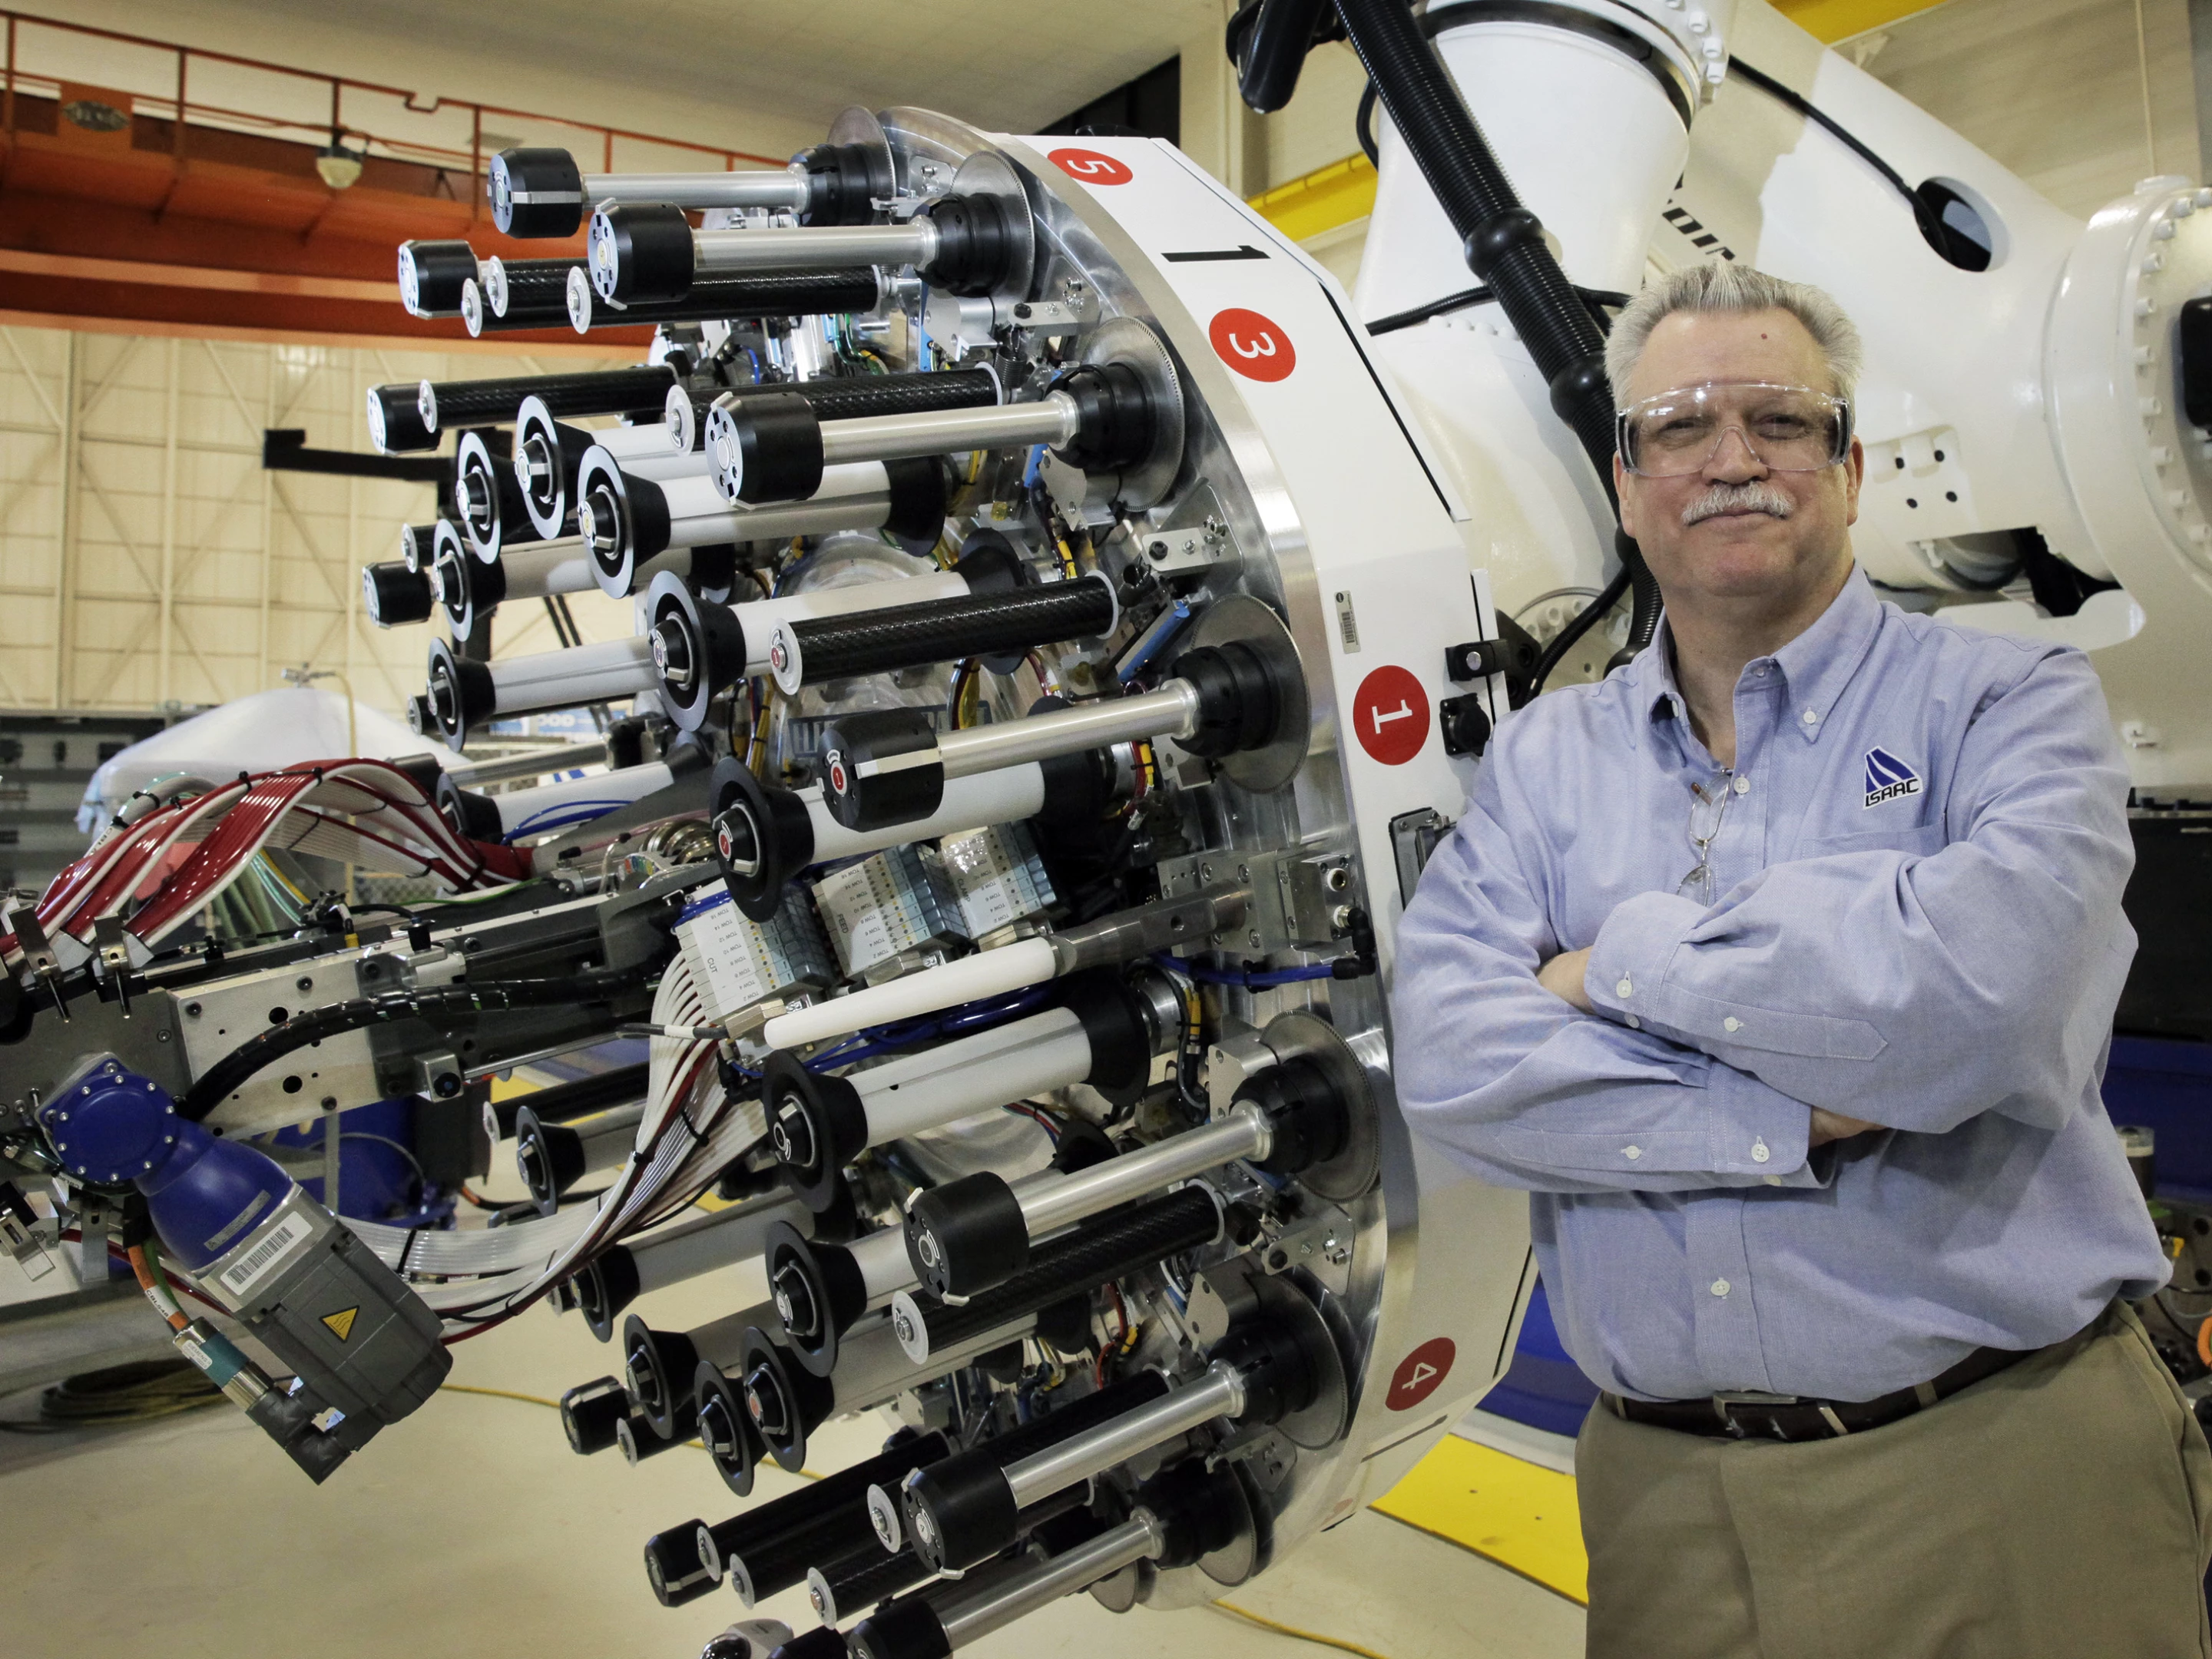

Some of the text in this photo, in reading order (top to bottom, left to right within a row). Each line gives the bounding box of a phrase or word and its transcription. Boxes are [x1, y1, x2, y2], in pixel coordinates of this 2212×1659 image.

[1066, 160, 1117, 174] 5
[1161, 245, 1271, 263] 1
[1228, 332, 1277, 359] 3
[1372, 699, 1413, 734] 1
[1865, 778, 1919, 807] ISAAC
[989, 892, 1001, 901] TOW
[994, 902, 1005, 911] TOW
[864, 914, 876, 922] TOW
[998, 913, 1010, 922] TOW
[721, 919, 733, 928] TOW
[837, 913, 849, 934] FEED
[725, 931, 738, 939] TOW
[869, 926, 881, 935] TOW
[873, 937, 885, 946] TOW
[730, 943, 742, 952] TOW
[877, 949, 889, 957] TOW
[734, 955, 747, 964] TOW
[707, 957, 718, 974] CUT
[739, 968, 751, 976] TOW
[743, 979, 756, 988] TOW
[747, 991, 760, 999] TOW
[1401, 1362, 1438, 1390] 4
